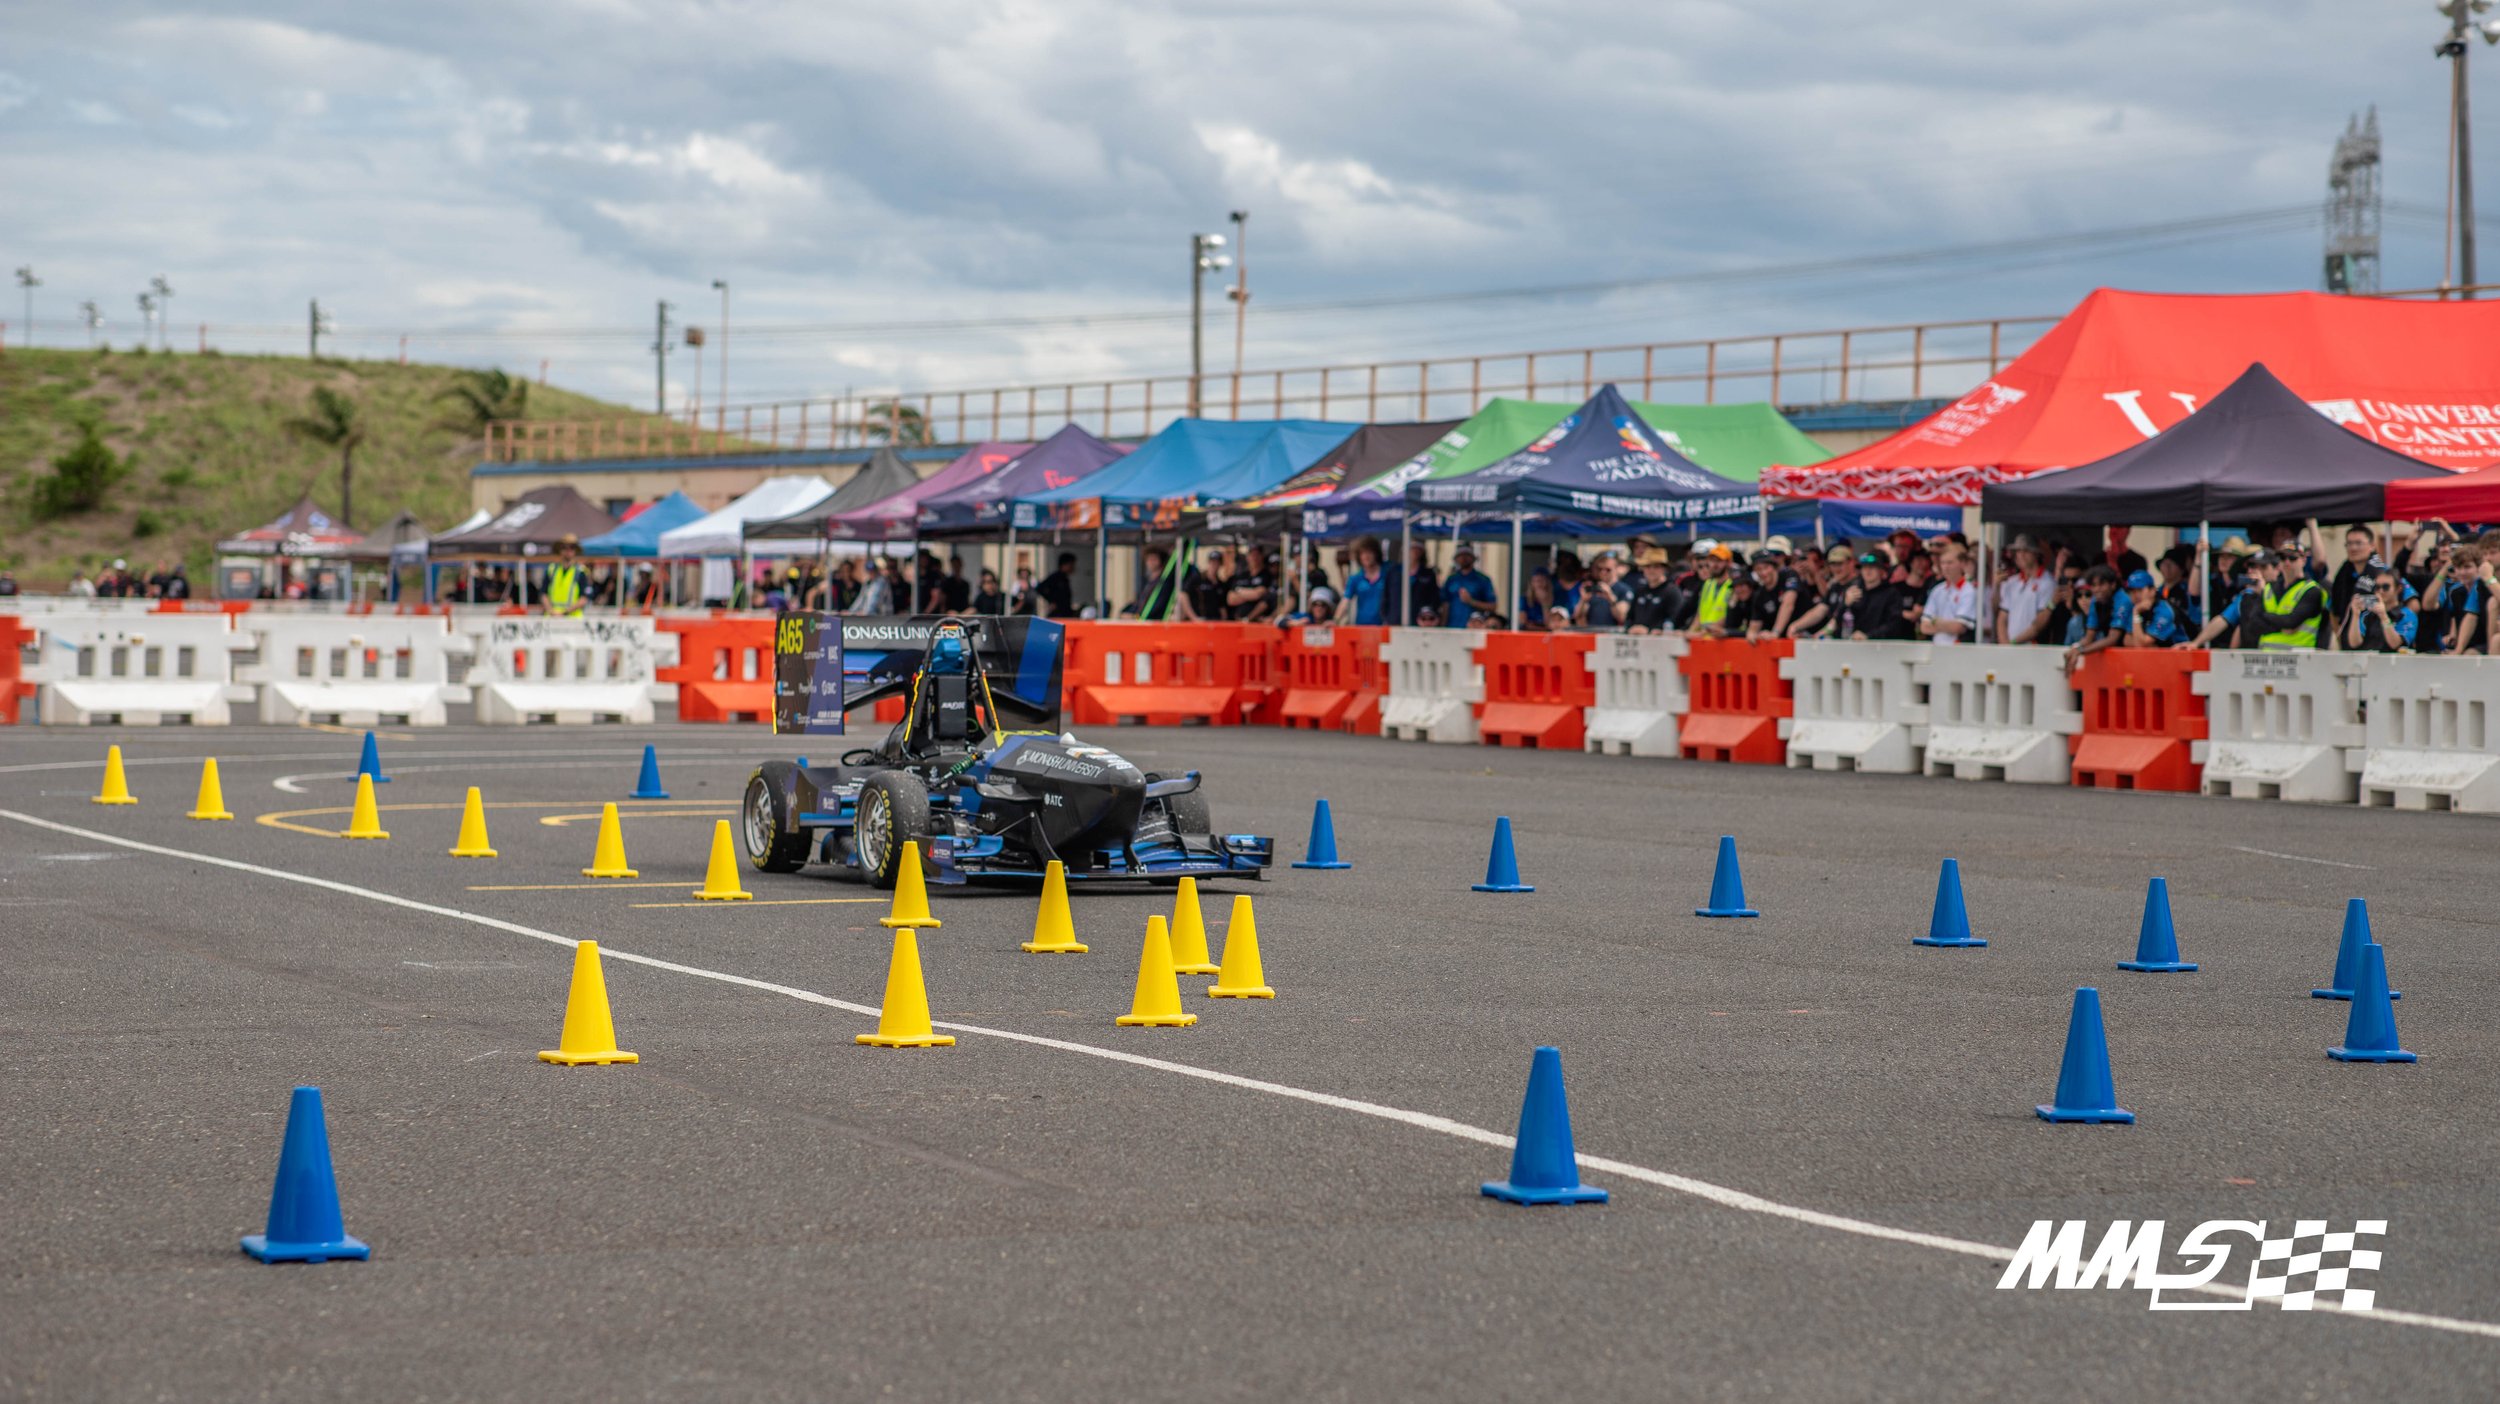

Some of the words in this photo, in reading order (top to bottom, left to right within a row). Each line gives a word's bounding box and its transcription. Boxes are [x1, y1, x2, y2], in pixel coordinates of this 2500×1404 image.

[1602, 495, 1684, 519] UNIVERSITY
[777, 617, 804, 655] A65
[1050, 795, 1063, 807] ATC
